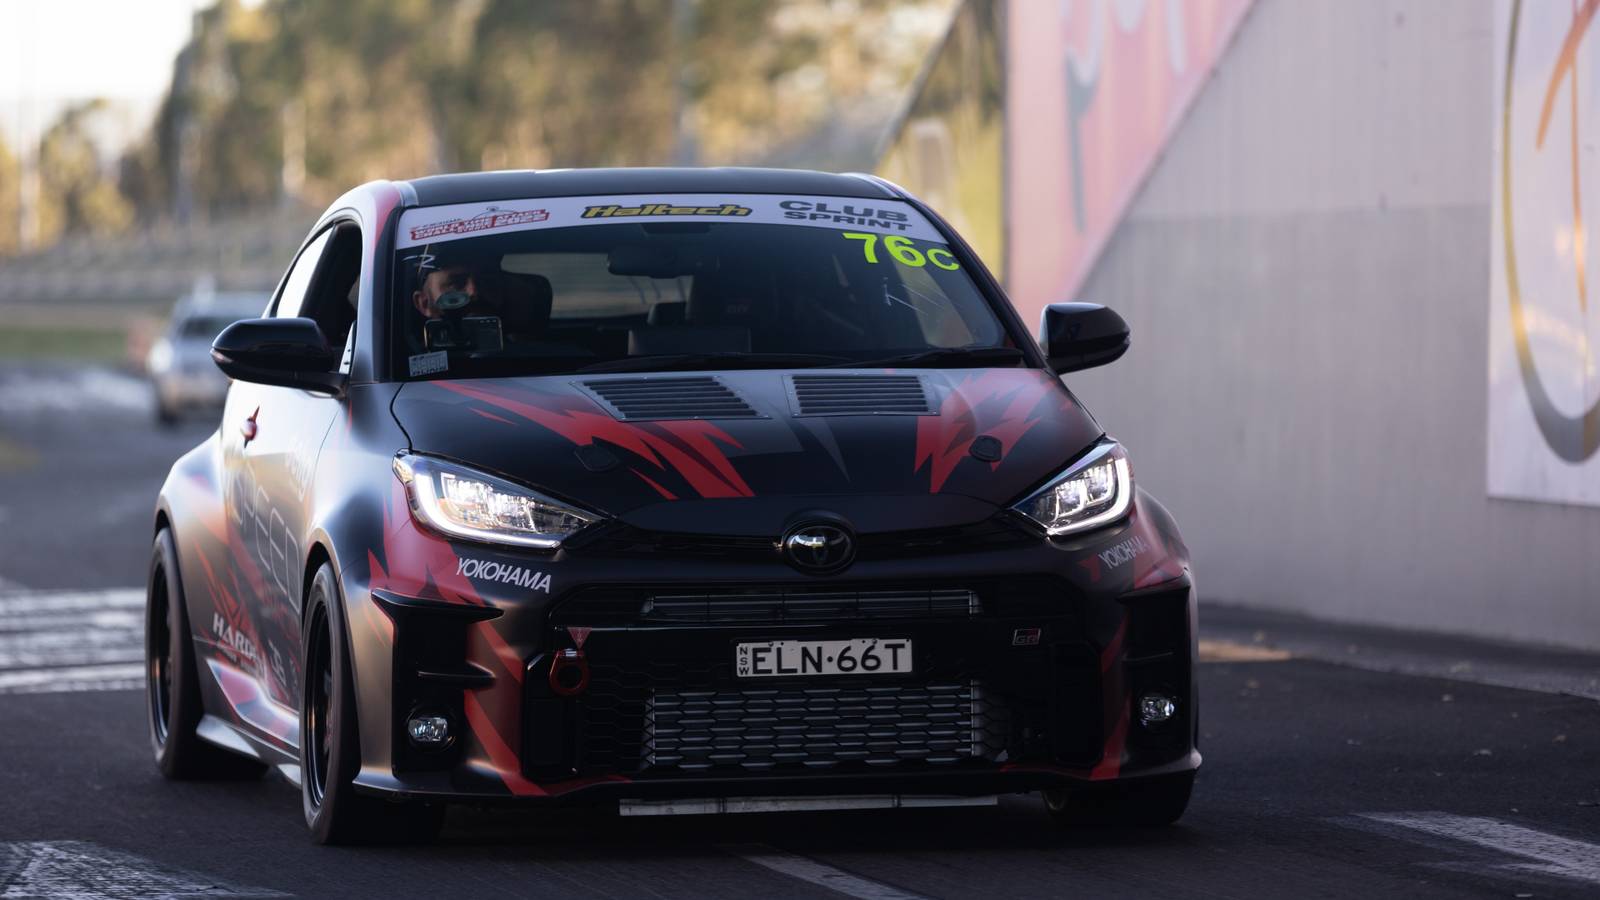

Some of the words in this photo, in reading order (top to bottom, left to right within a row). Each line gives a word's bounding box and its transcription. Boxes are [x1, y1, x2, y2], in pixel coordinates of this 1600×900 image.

[581, 203, 752, 218] Haltech
[779, 200, 908, 222] CLUB
[784, 211, 913, 231] SPRINT
[456, 557, 552, 594] YOKOHAMA
